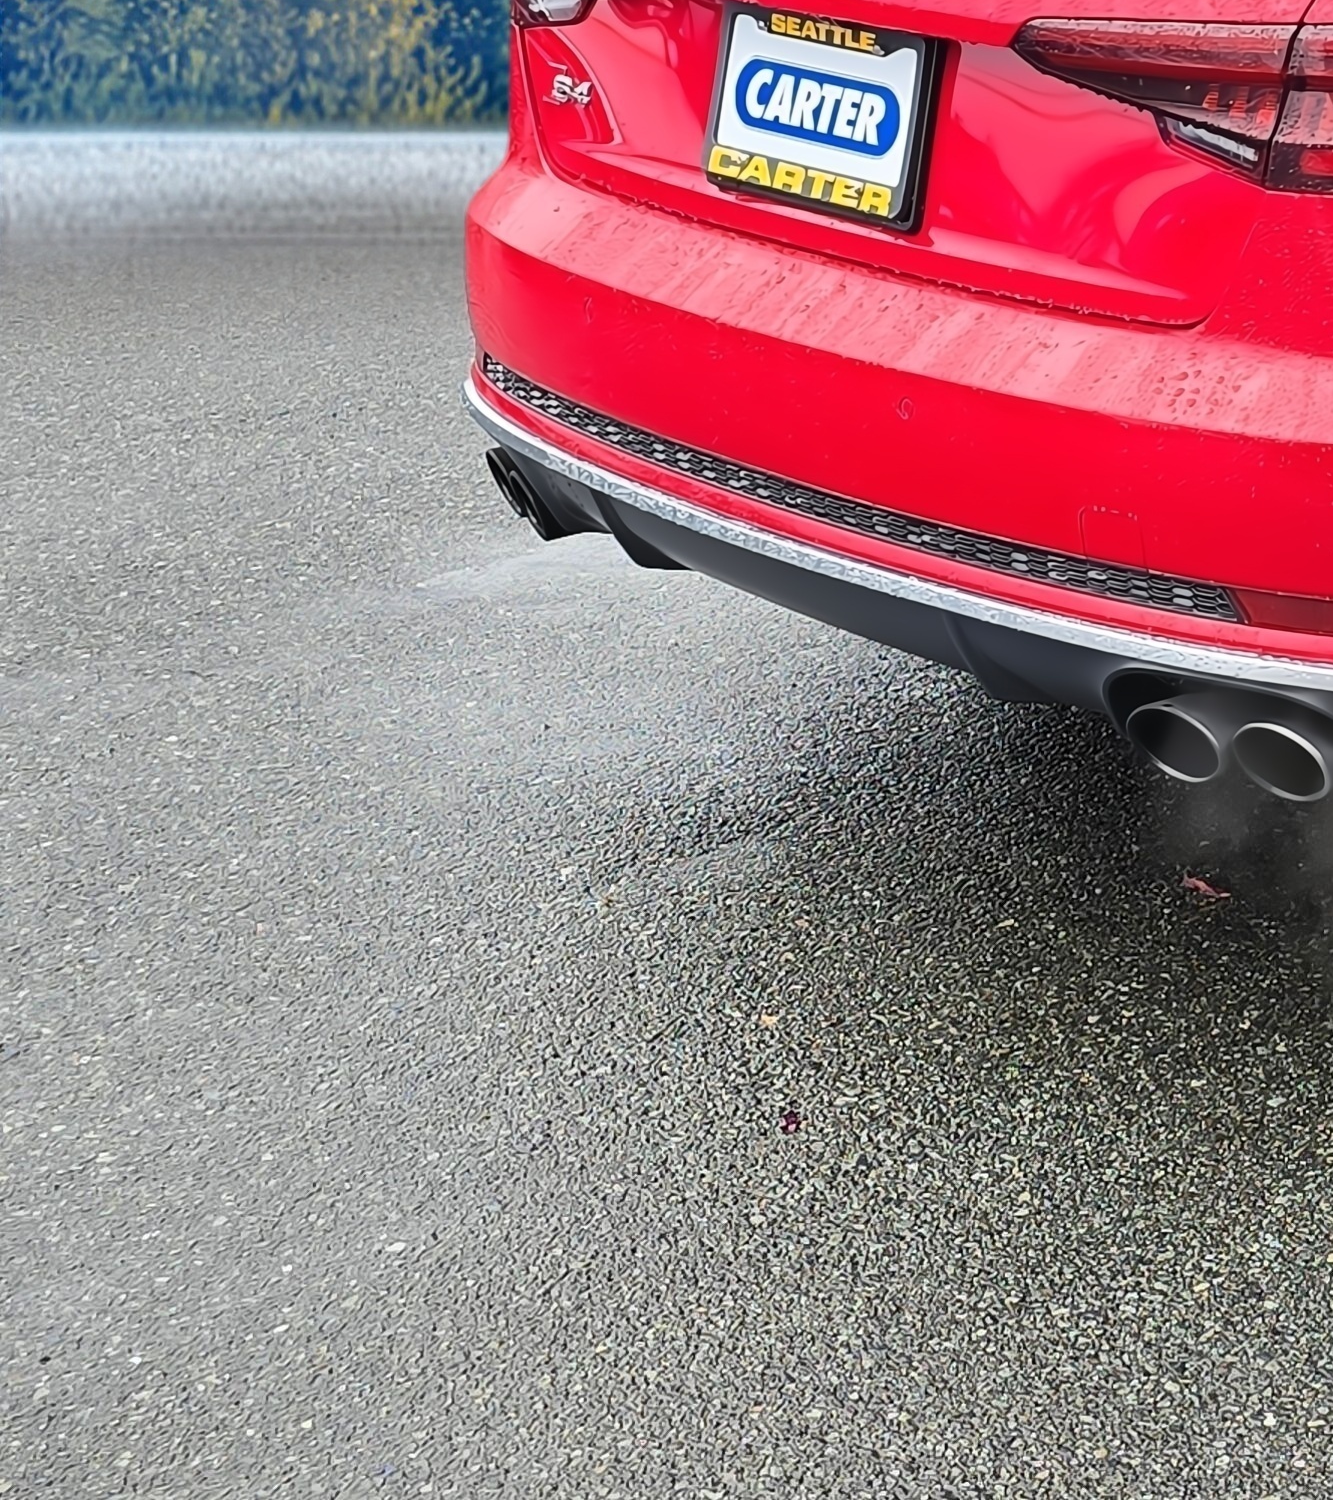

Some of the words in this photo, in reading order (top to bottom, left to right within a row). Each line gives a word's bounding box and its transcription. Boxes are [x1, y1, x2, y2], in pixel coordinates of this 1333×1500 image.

[769, 13, 877, 52] SEATTLE
[745, 67, 887, 147] CARTER
[707, 145, 892, 218] CARTER
